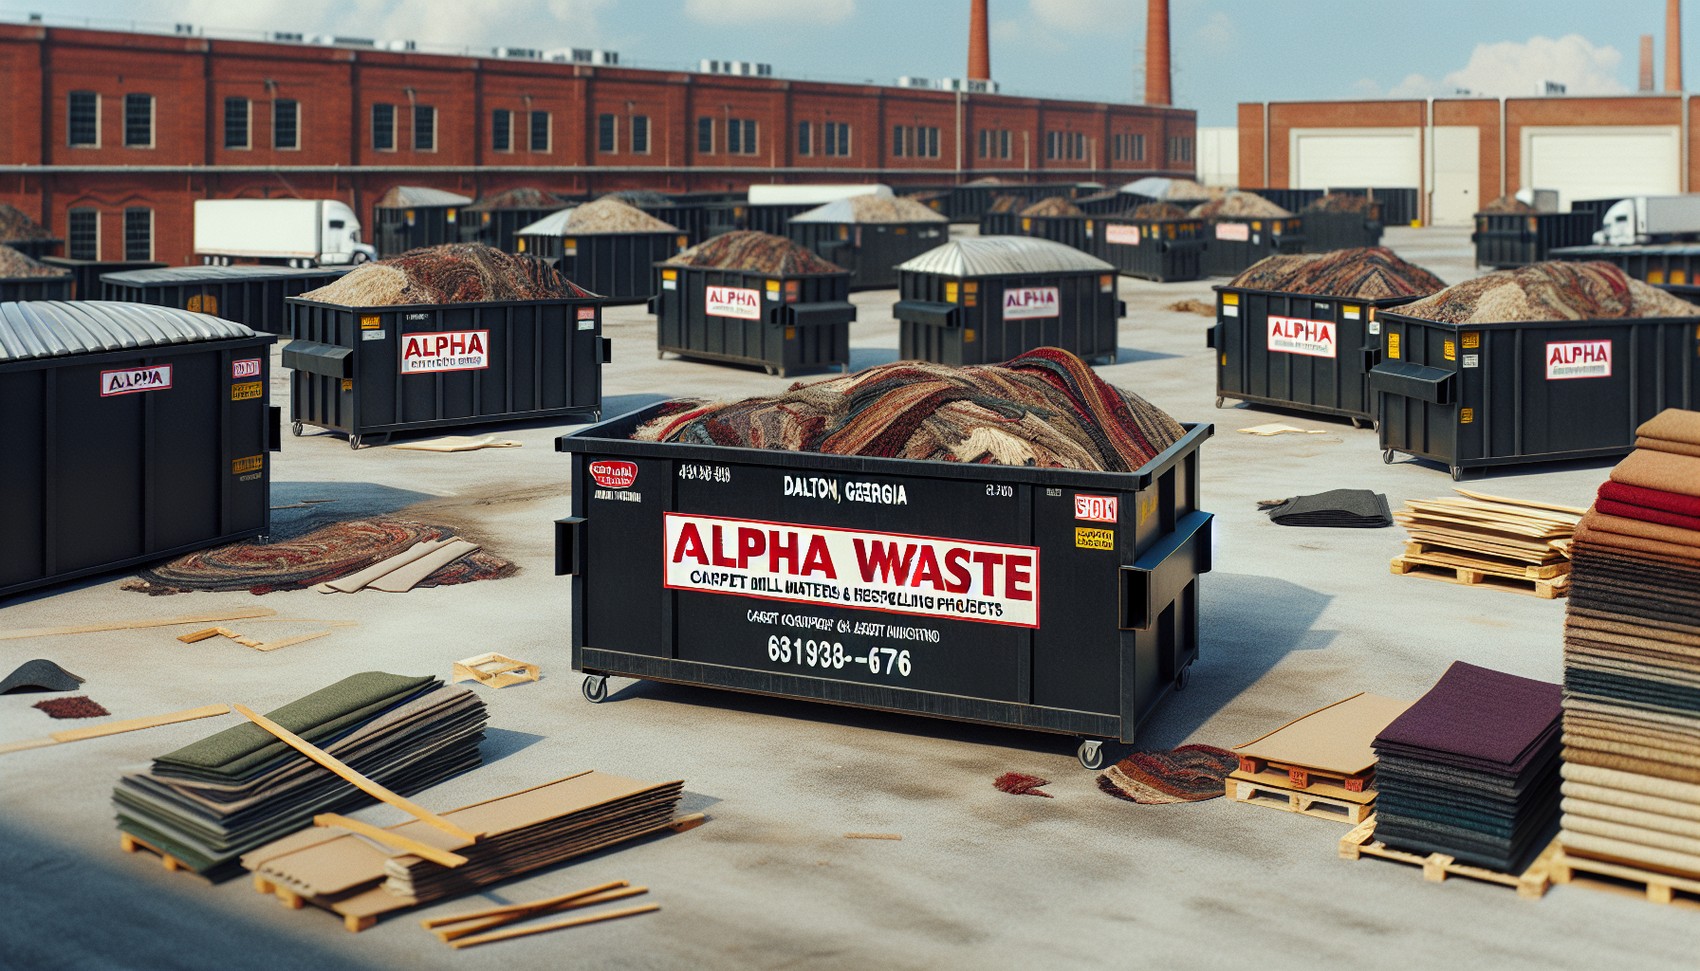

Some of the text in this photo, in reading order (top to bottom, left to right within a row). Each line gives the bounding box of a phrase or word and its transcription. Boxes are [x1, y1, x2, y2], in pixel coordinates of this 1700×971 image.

[710, 290, 757, 307] ALPHA
[1006, 290, 1055, 307] ALPHA
[1272, 320, 1332, 344] ALPHA
[404, 333, 485, 360] ALPHA
[1549, 344, 1608, 366] ALPHA
[783, 475, 842, 505] DALTON,
[672, 522, 1033, 602] ALPHA WASTE
